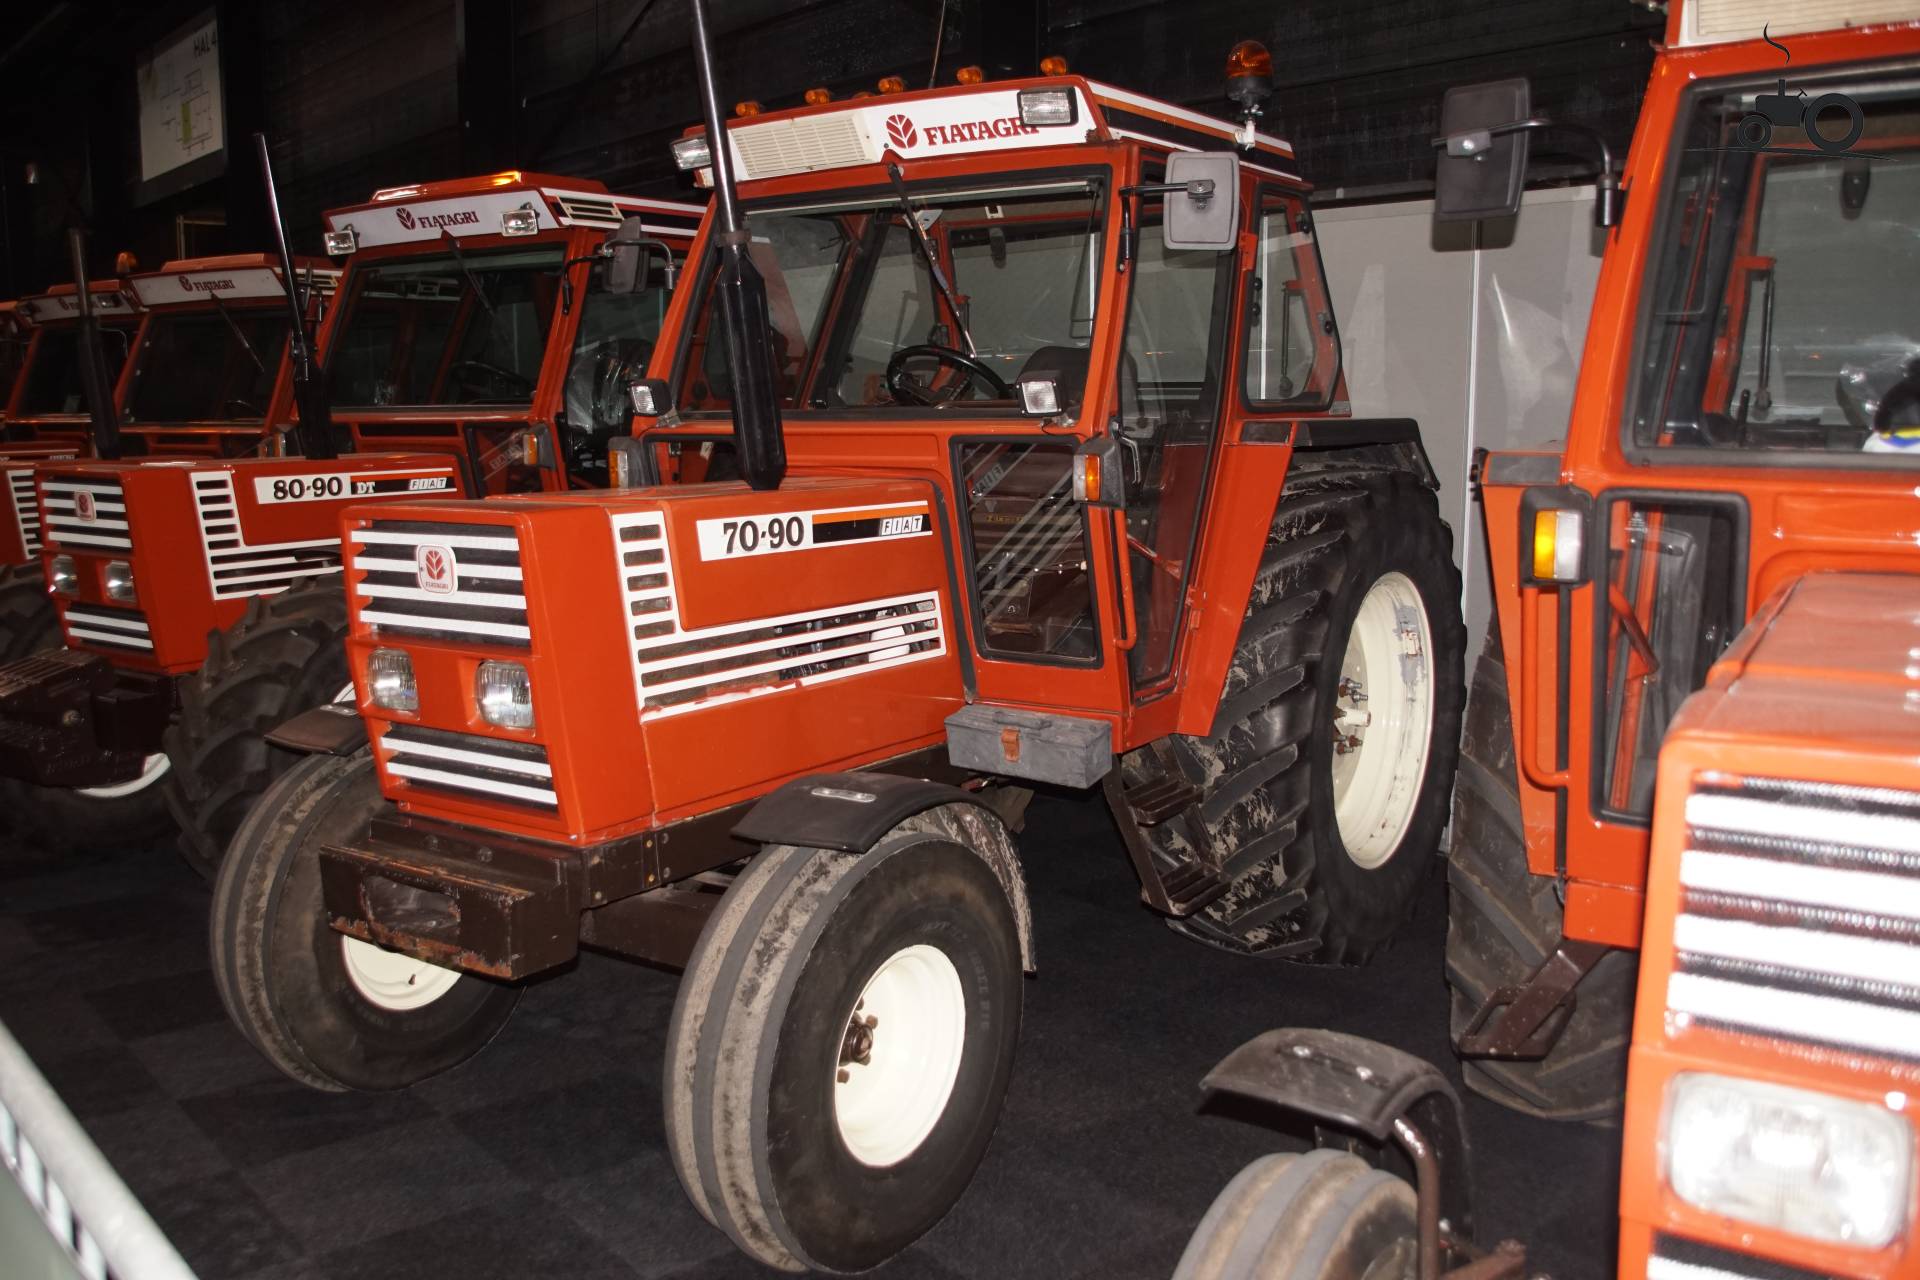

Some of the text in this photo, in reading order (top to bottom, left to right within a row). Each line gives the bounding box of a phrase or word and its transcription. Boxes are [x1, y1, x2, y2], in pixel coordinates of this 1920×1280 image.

[417, 211, 480, 229] FIATAGRI
[356, 481, 376, 495] DT
[410, 478, 447, 490] FIAT
[881, 515, 923, 535] FIAT
